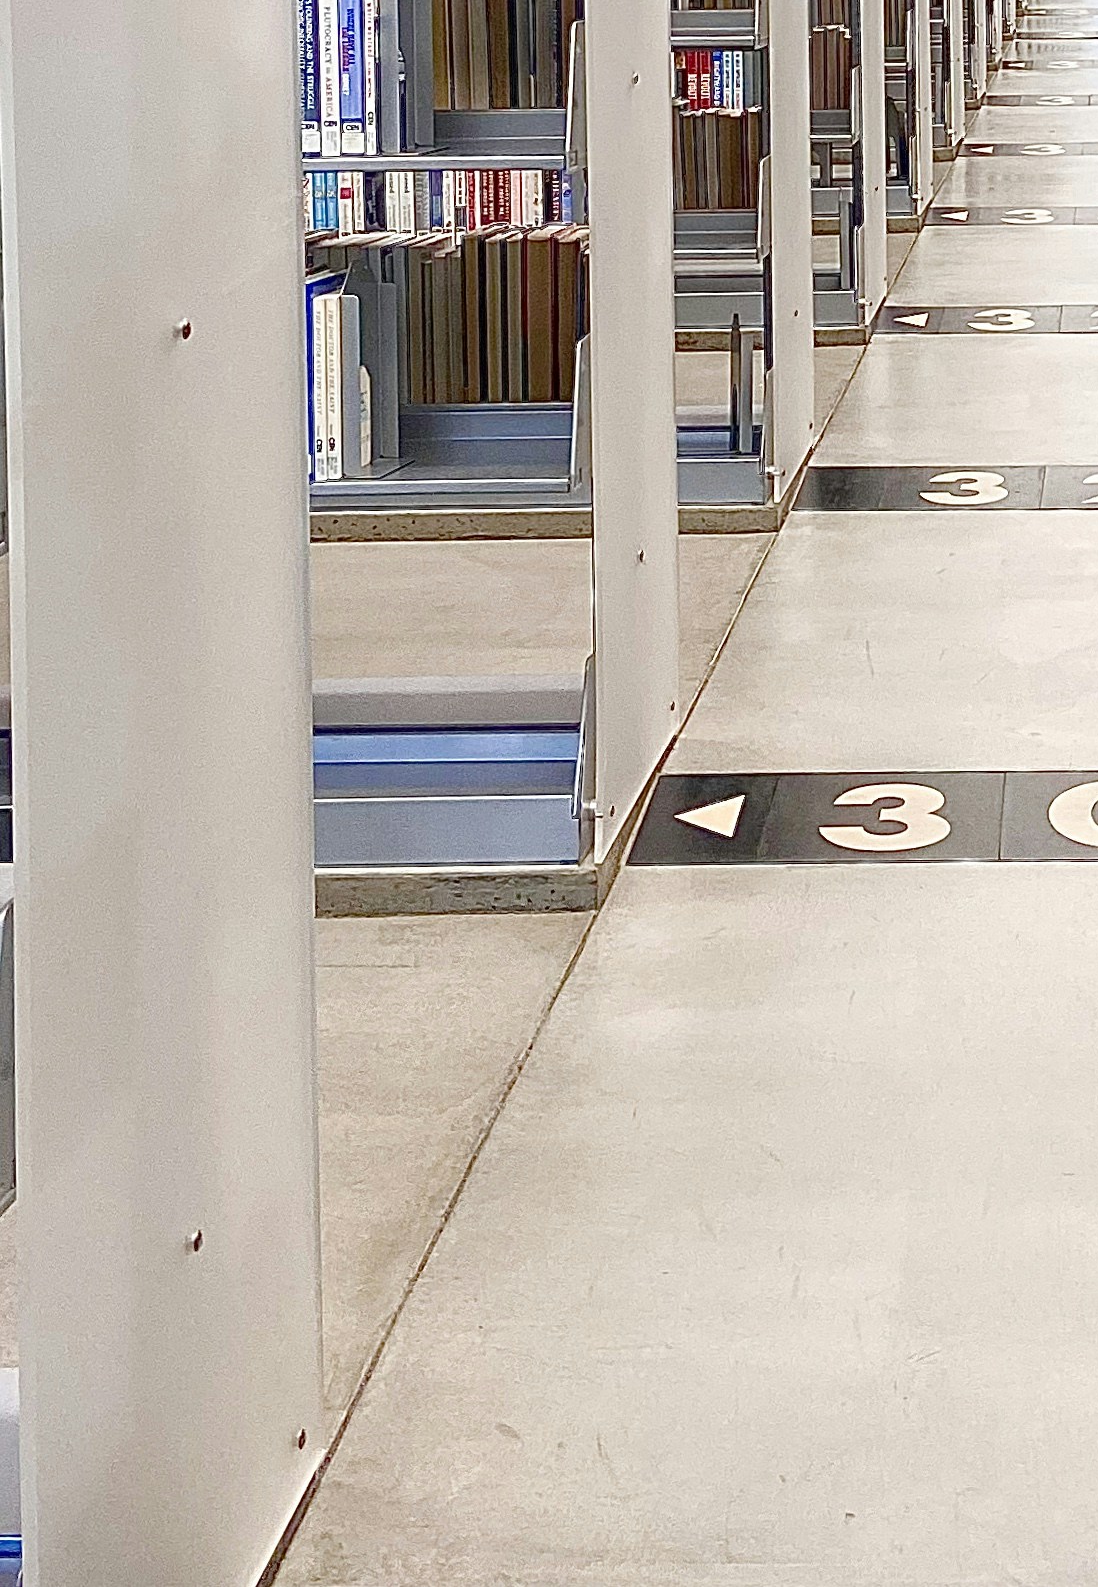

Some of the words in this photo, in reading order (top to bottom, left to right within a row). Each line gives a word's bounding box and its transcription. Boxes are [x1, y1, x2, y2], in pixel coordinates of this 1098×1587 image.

[305, 6, 314, 42] FOUNDING
[324, 6, 333, 64] PLUTOCRACY
[305, 75, 314, 109] STRUGGLE
[324, 77, 333, 118] AMERICA
